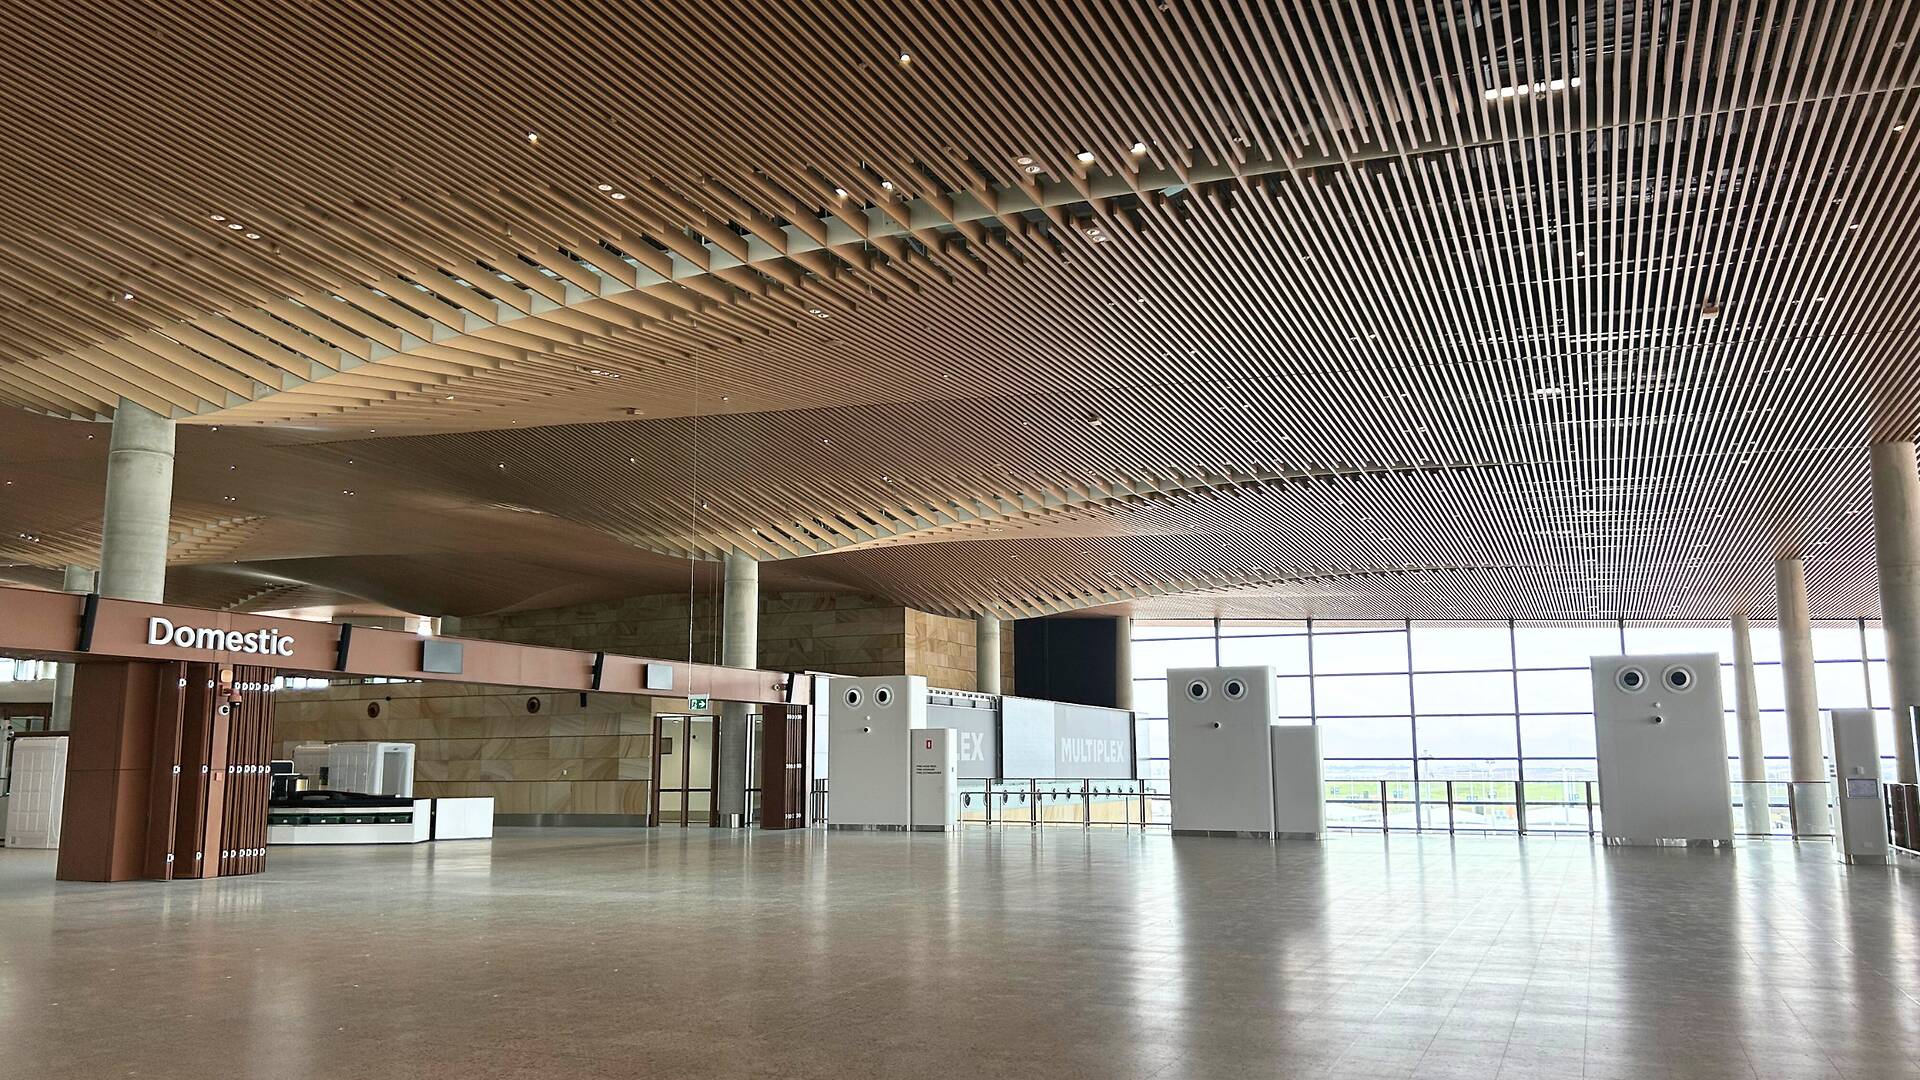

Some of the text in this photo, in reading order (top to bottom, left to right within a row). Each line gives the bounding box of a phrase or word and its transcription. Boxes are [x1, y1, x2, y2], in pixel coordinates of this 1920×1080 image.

[148, 616, 295, 657] Domestic
[957, 732, 985, 761] EX
[1061, 736, 1125, 763] MULTIPLEX
